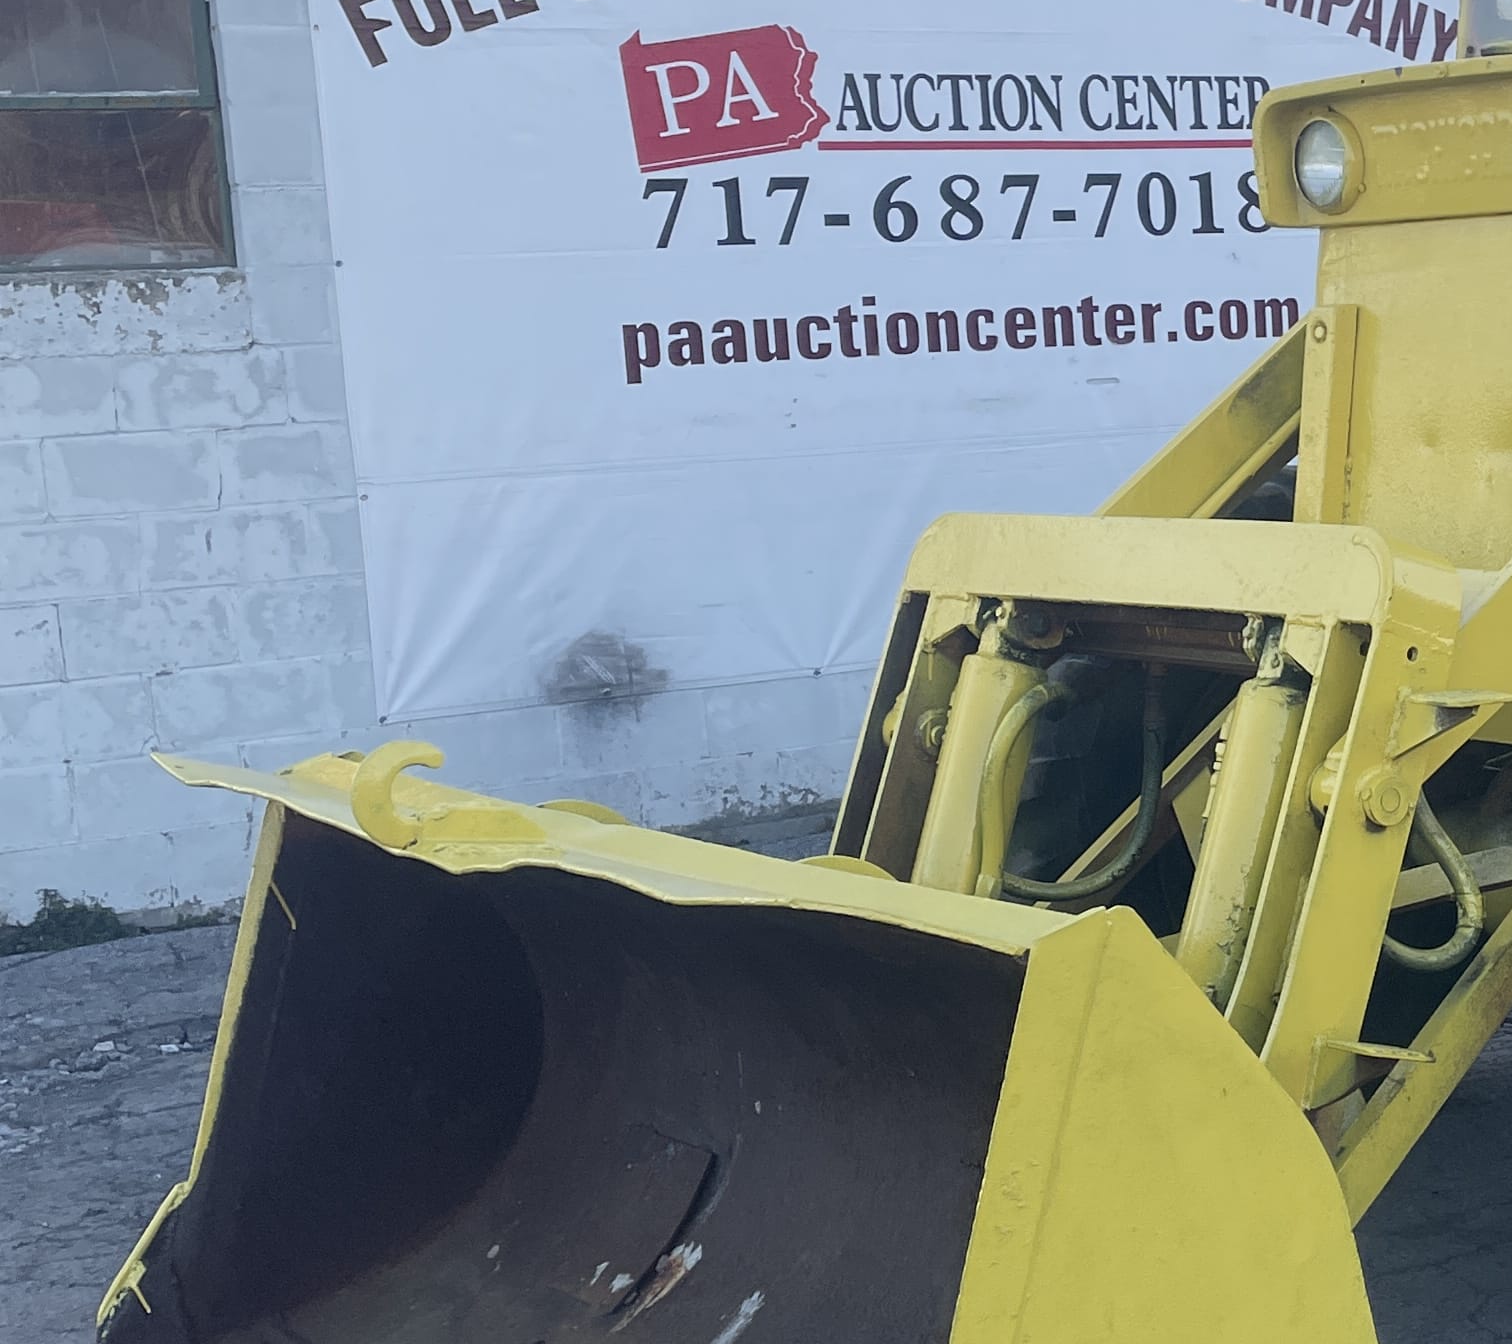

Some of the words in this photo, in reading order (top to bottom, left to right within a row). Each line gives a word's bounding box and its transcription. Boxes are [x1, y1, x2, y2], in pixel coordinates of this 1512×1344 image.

[644, 49, 780, 139] PA
[835, 73, 1064, 133] AUCTION
[641, 171, 1272, 250] 717-687-7018
[621, 295, 1299, 385] paauctioncenter.com
